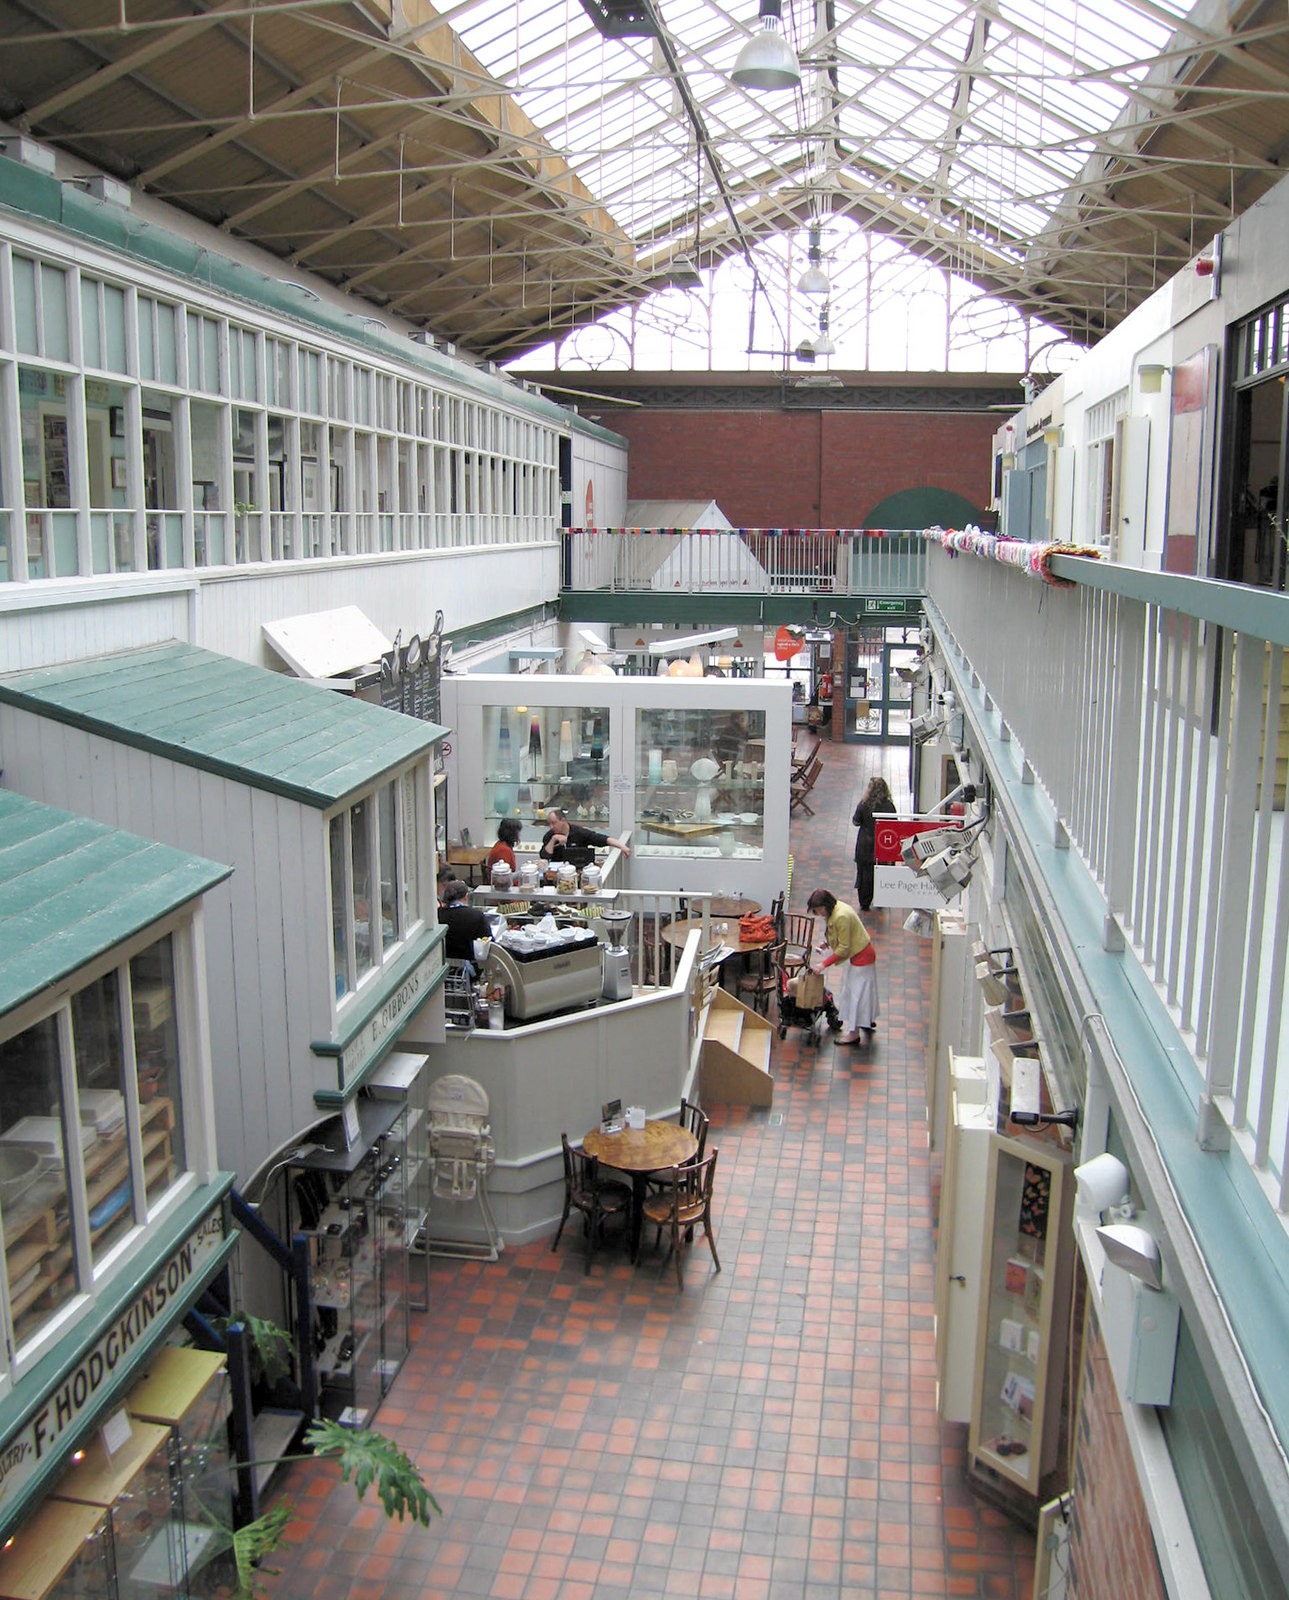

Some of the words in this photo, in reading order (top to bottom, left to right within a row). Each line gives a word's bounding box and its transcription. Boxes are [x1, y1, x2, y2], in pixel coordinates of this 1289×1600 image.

[880, 880, 896, 890] Lee
[897, 880, 919, 892] Page
[382, 973, 420, 1028] GIBBONS
[54, 1243, 193, 1433] HODGKINSON
